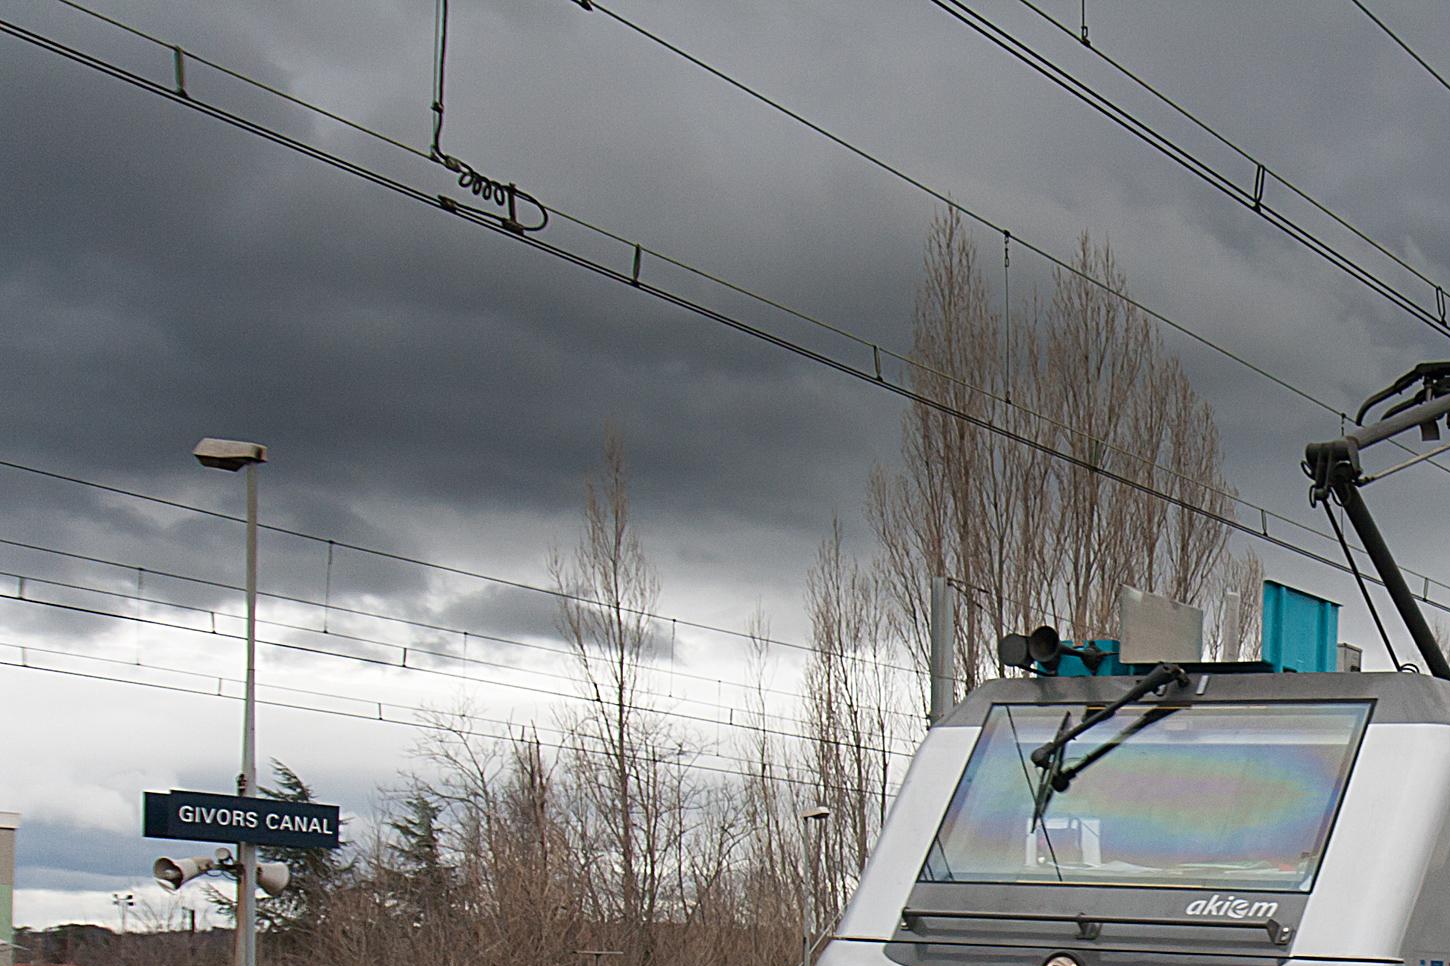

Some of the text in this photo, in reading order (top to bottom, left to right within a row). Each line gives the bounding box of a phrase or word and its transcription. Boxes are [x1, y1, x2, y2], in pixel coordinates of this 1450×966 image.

[178, 805, 333, 835] GIVORS CANAL
[1185, 894, 1279, 919] akiem
